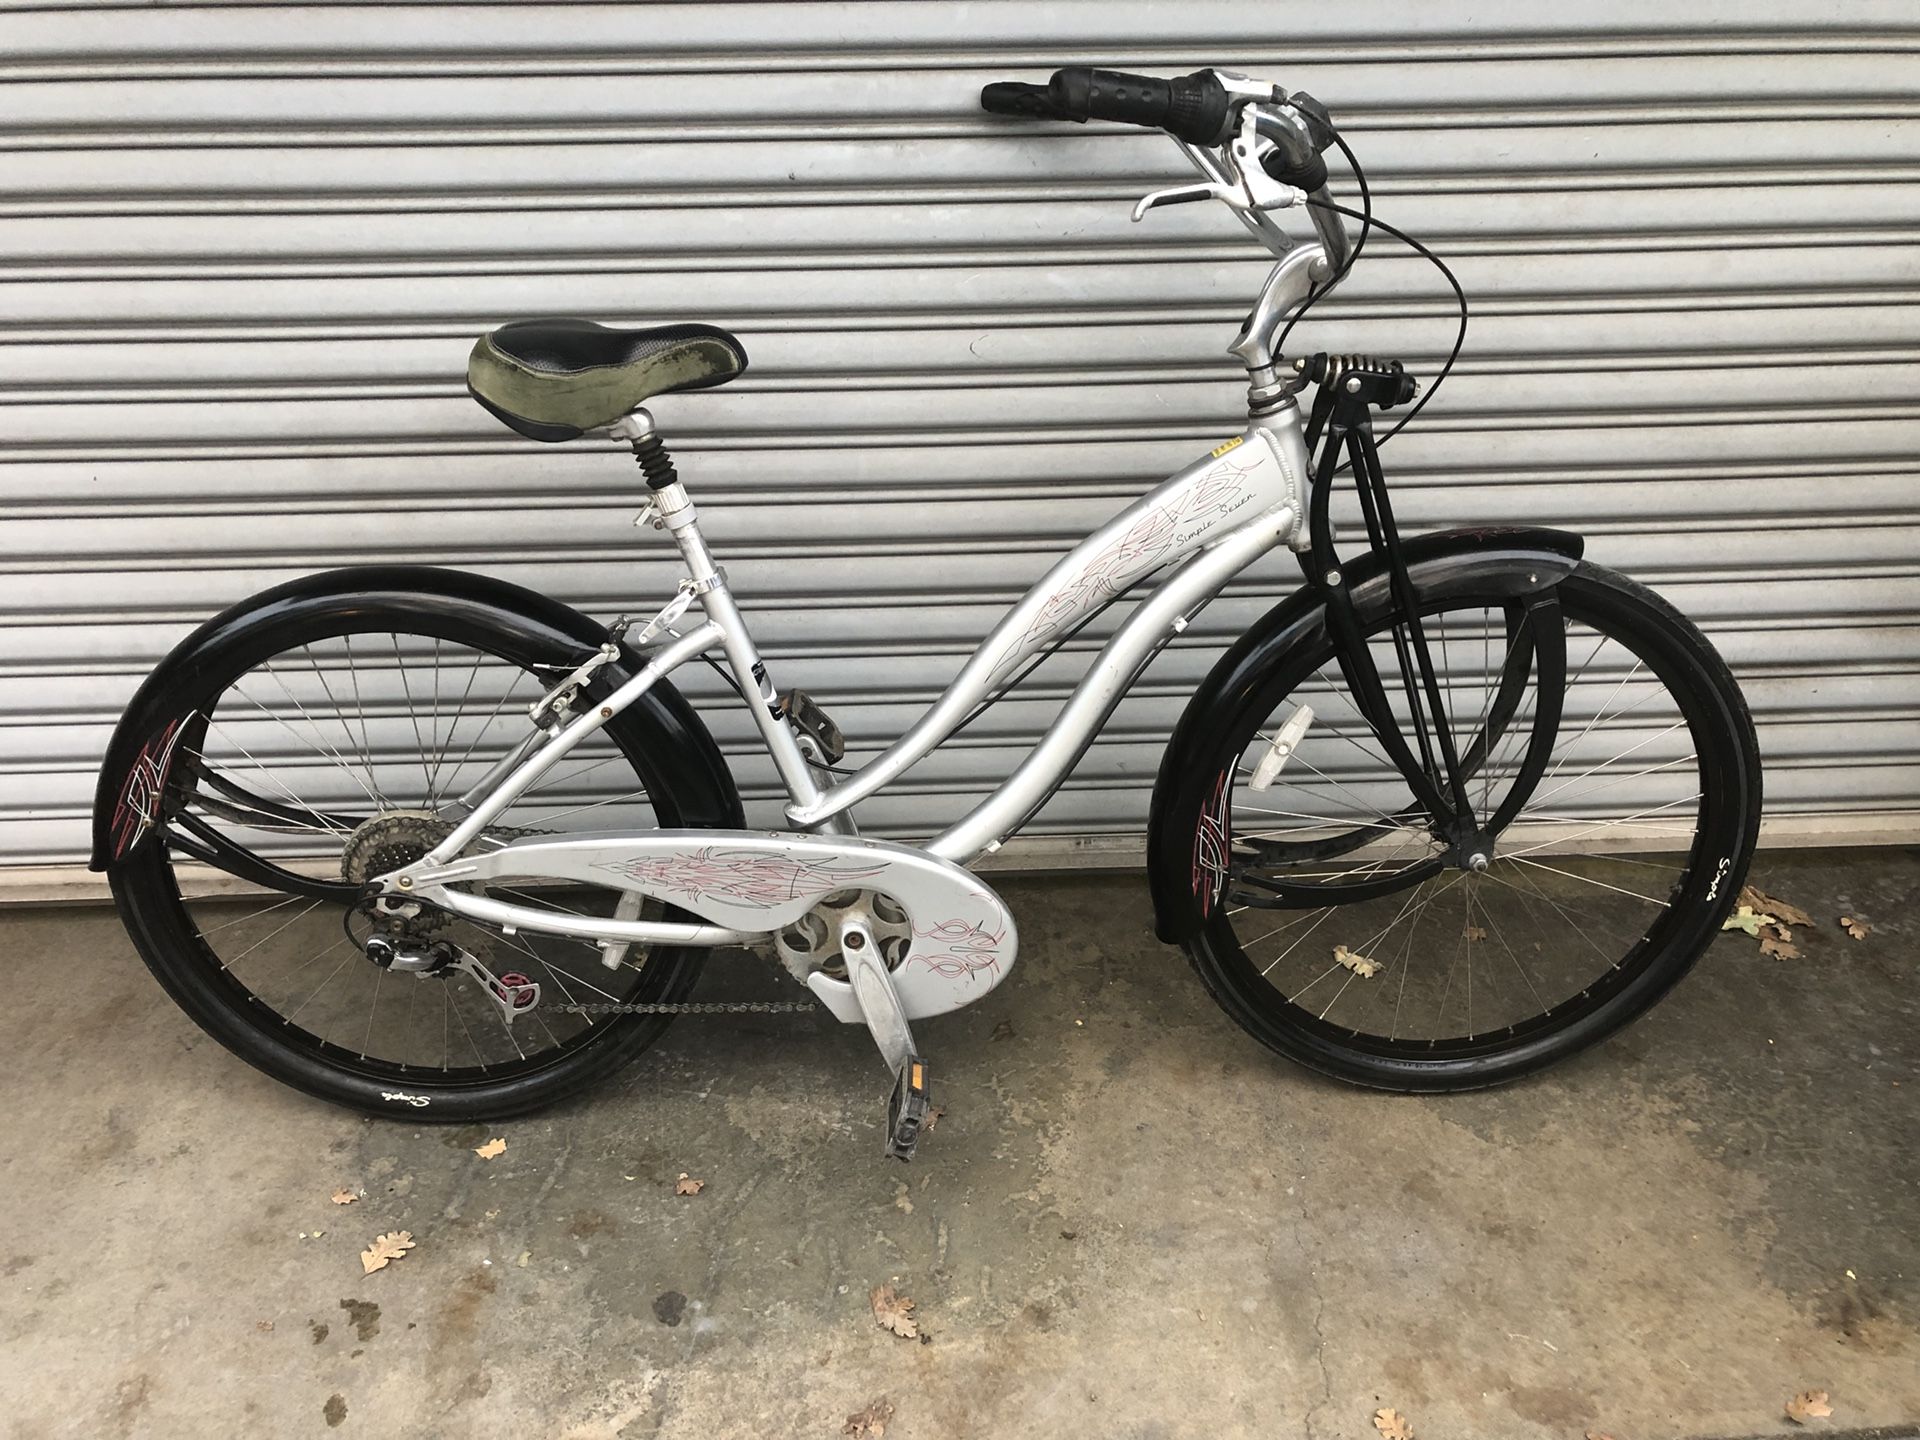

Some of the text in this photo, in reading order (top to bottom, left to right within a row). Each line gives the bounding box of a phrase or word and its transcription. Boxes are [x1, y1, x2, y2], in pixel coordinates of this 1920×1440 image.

[1176, 493, 1257, 548] Simple Seven
[1706, 857, 1731, 902] Simple
